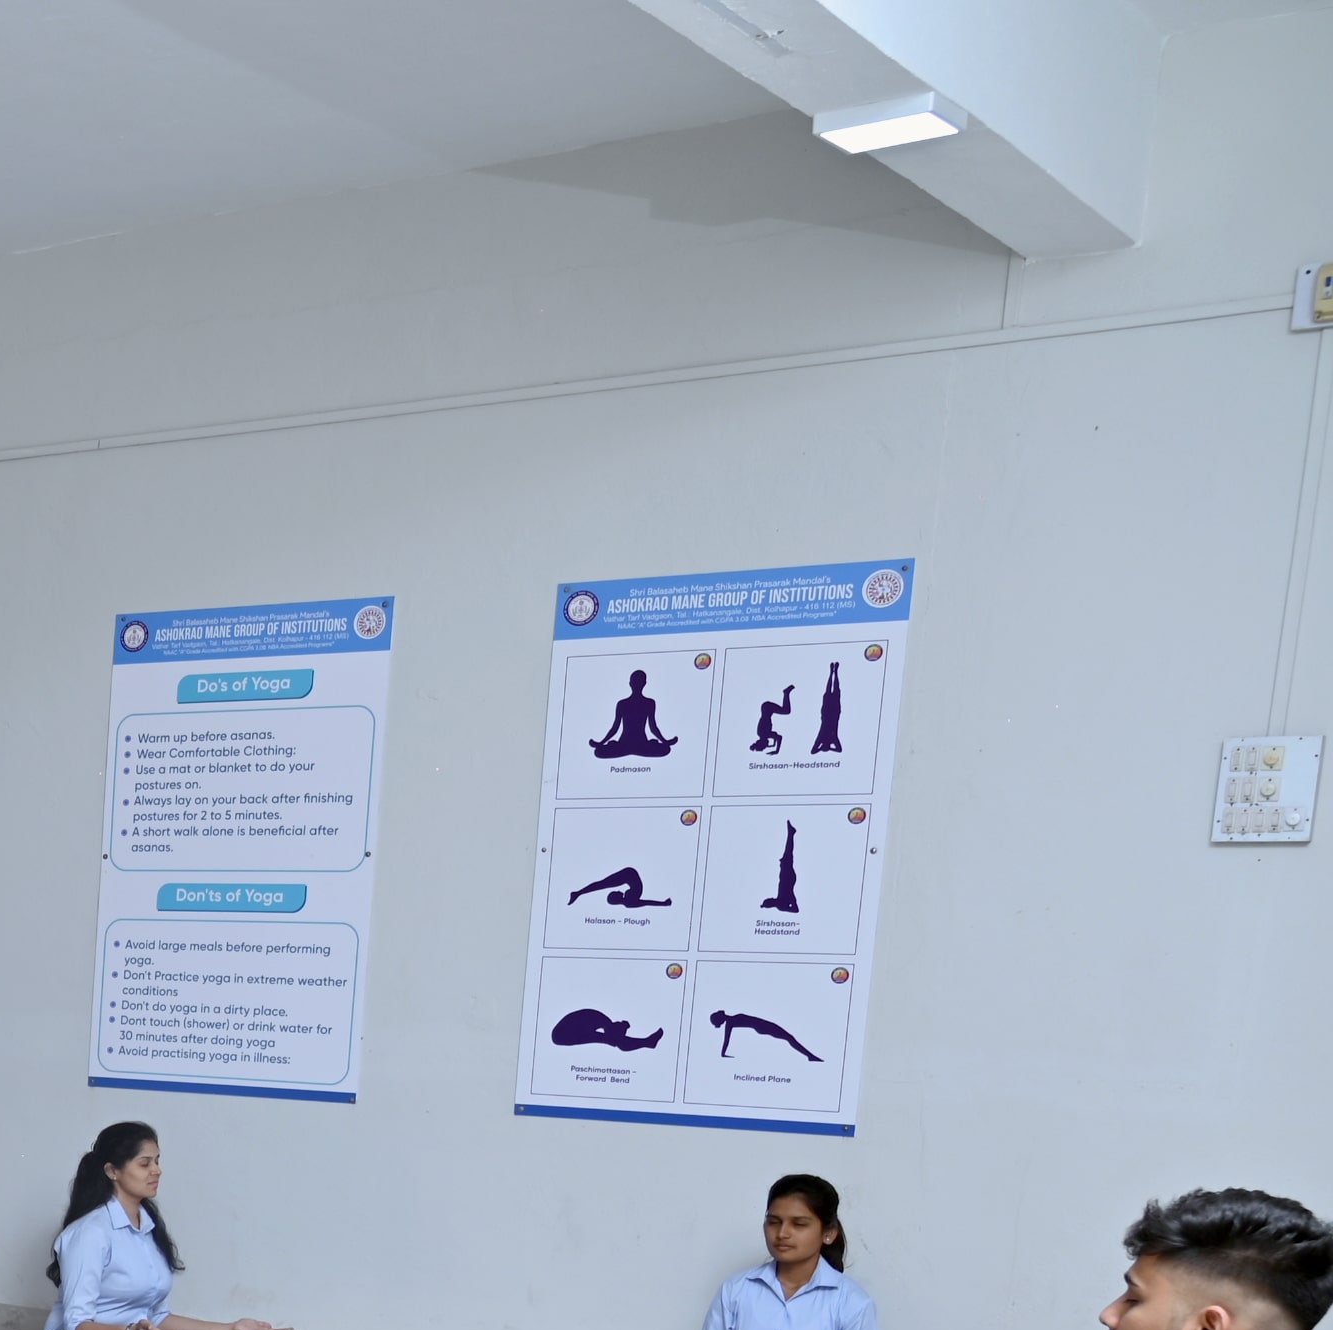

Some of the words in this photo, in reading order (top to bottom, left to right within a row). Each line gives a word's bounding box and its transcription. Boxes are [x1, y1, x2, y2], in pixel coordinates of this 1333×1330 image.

[607, 596, 669, 614] ASHOKRAO
[671, 593, 706, 610] MANE
[708, 590, 748, 608] GROUP
[750, 589, 767, 605] OF
[769, 583, 854, 604] INSTITUTIONS
[154, 626, 203, 642] ASHOKRAO
[205, 624, 232, 639] MANE
[234, 622, 265, 637] GROUP
[267, 622, 280, 636] OF
[281, 617, 347, 634] INSTITUTIONS
[197, 678, 228, 693] Do's
[232, 677, 248, 692] of
[251, 676, 291, 694] Yoga
[137, 733, 170, 744] Warm
[173, 734, 188, 745] up
[190, 731, 227, 742] before
[230, 731, 275, 741] asanas.
[137, 748, 167, 759] Wear
[169, 746, 241, 759] Comfortable
[135, 764, 156, 775] Use
[158, 766, 166, 775] a
[169, 764, 191, 774] mat
[194, 765, 206, 774] or
[208, 762, 252, 774] blanket
[255, 762, 267, 772] to
[269, 761, 286, 772] do
[289, 762, 315, 774] your
[749, 760, 841, 770] Sirshasan-Headstand
[134, 780, 182, 793] postures
[184, 781, 202, 790] on.
[133, 795, 172, 808] Always
[175, 794, 192, 808] lay
[194, 797, 209, 805] on
[211, 796, 237, 807] your
[239, 793, 268, 804] back
[271, 793, 301, 804] after
[303, 792, 353, 806] finishing
[133, 812, 180, 824] postures
[183, 810, 198, 821] for
[200, 810, 207, 821] 2
[210, 811, 222, 821] to
[225, 809, 232, 821] 5
[234, 809, 283, 820] minutes.
[131, 826, 140, 837] A
[143, 826, 171, 837] short
[173, 826, 199, 837] walk
[201, 825, 234, 837] alone
[237, 826, 246, 836] is
[249, 824, 306, 836] beneficial
[309, 824, 339, 836] after
[131, 844, 174, 852] asanas.
[176, 888, 222, 902] Don'ts
[225, 888, 242, 902] of
[245, 888, 284, 906] Yoga
[584, 917, 616, 925] Halasan
[623, 917, 651, 927] Plough
[756, 919, 800, 927] Sirshasan-
[754, 928, 801, 936] Headstand
[125, 939, 156, 950] Avoid
[158, 940, 187, 953] large
[189, 940, 223, 952] meals
[225, 941, 263, 953] before
[265, 943, 331, 958] performing
[124, 957, 155, 968] yoga.
[123, 969, 151, 981] Don't
[154, 970, 199, 982] Practice
[202, 974, 231, 986] yoga
[234, 973, 244, 983] in
[246, 975, 295, 986] extreme
[297, 976, 348, 988] weather
[122, 985, 179, 997] conditions
[121, 1000, 149, 1011] Don't
[152, 1001, 167, 1012] do
[169, 1004, 198, 1016] yoga
[200, 1003, 210, 1014] in
[213, 1006, 221, 1014] a
[223, 1004, 251, 1018] dirty
[253, 1004, 288, 1018] place.
[120, 1015, 147, 1026] Dont
[149, 1017, 181, 1028] touch
[183, 1016, 230, 1031] (shower)
[232, 1022, 245, 1031] or
[247, 1021, 276, 1032] drink
[279, 1024, 313, 1034] water
[316, 1023, 333, 1035] for
[119, 1030, 133, 1041] 30
[135, 1031, 178, 1043] minutes
[180, 1033, 208, 1044] after
[210, 1035, 243, 1049] doing
[246, 1039, 276, 1050] yoga
[118, 1045, 149, 1057] Avoid
[151, 1048, 206, 1062] practising
[209, 1052, 238, 1064] yoga
[240, 1051, 251, 1062] in
[570, 1065, 631, 1075] Paschimottasan
[575, 1074, 607, 1083] Forward
[610, 1076, 630, 1084] Bend
[733, 1073, 766, 1082] Inclined
[767, 1075, 791, 1084] Plane
